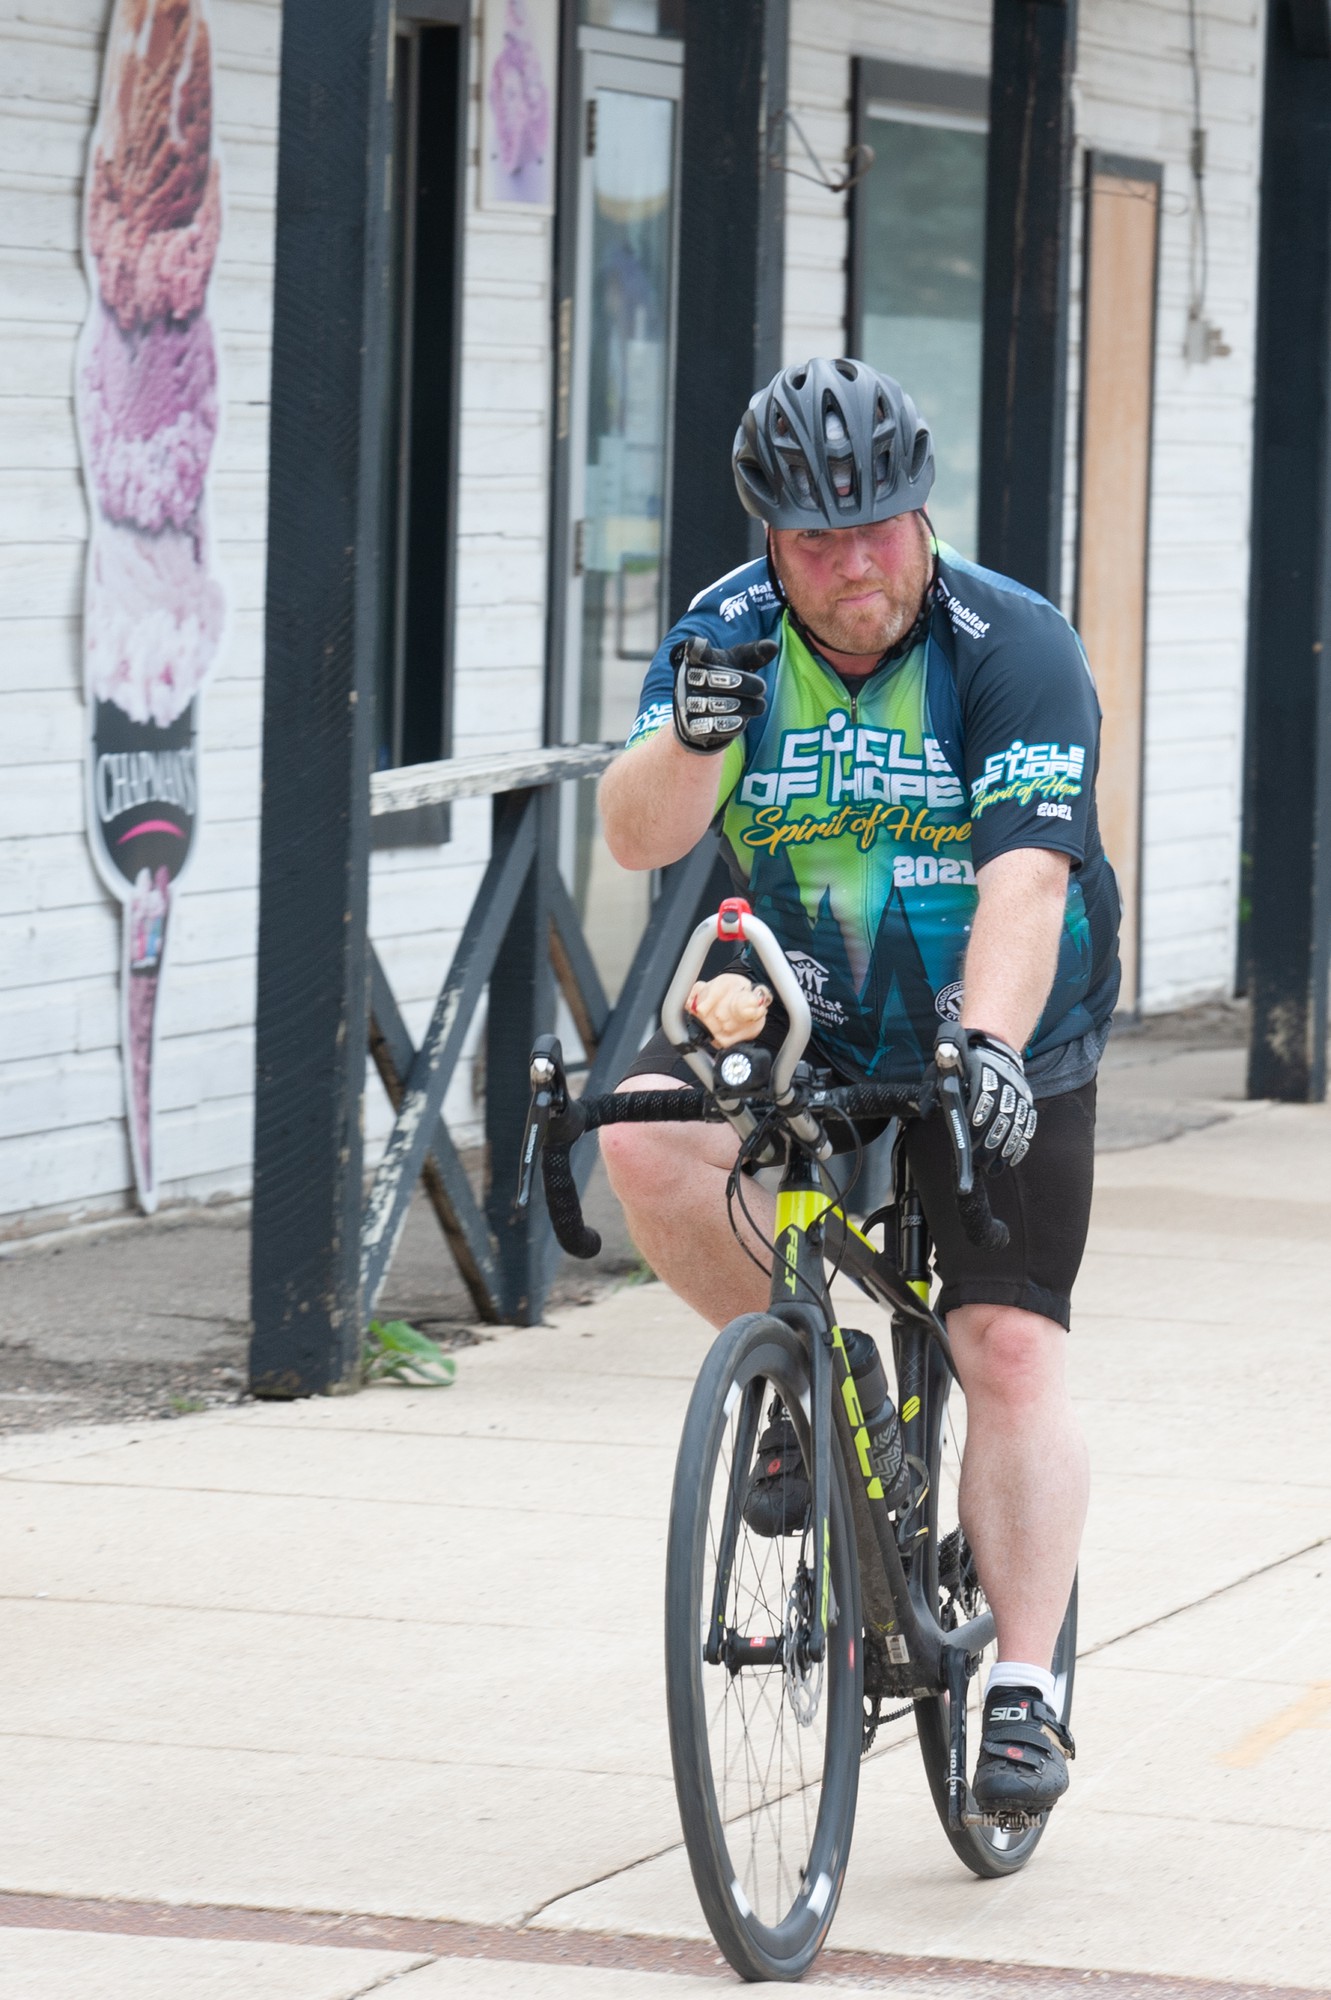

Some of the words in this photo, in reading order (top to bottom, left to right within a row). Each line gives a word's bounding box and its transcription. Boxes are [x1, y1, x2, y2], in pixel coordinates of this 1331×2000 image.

[948, 597, 990, 633] Habitat
[782, 712, 953, 772] CYCLE
[985, 741, 1085, 775] CYCLE
[741, 770, 818, 806] OF
[832, 766, 964, 808] HOPE
[971, 769, 1002, 799] OF
[1007, 761, 1083, 781] HOPE
[971, 781, 1020, 819] Spirit
[1016, 778, 1040, 804] of
[1035, 775, 1082, 803] Hope
[743, 806, 852, 856] Spirit
[850, 804, 884, 850] of
[880, 806, 972, 852] Hope
[1037, 802, 1072, 821] 2021
[893, 856, 977, 887] 2021
[803, 989, 844, 1014] bitat
[950, 1108, 966, 1149] SHIMANO
[989, 1702, 1028, 1722] SIDI
